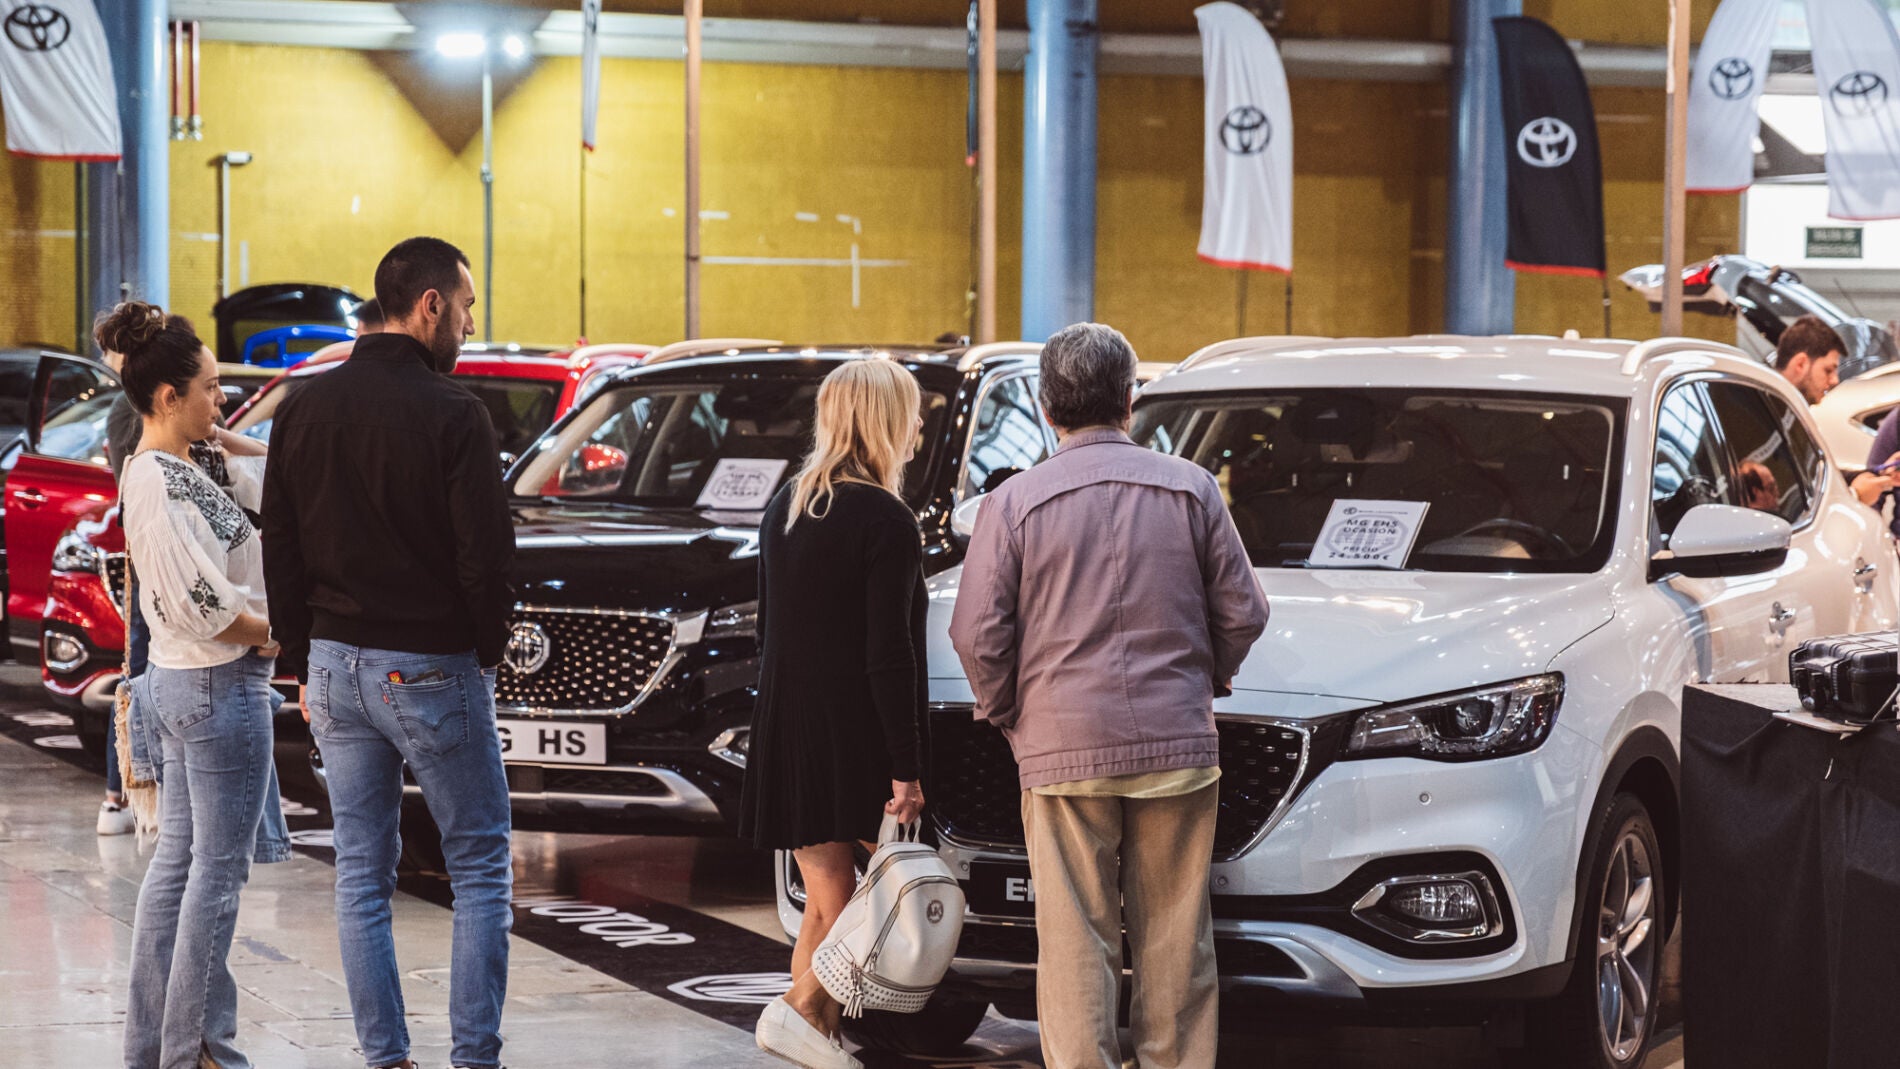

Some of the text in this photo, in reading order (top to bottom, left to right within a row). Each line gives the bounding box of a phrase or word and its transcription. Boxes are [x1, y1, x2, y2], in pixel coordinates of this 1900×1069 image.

[1346, 519, 1399, 527] MG EHS
[506, 624, 548, 673] MG
[538, 729, 586, 756] HS
